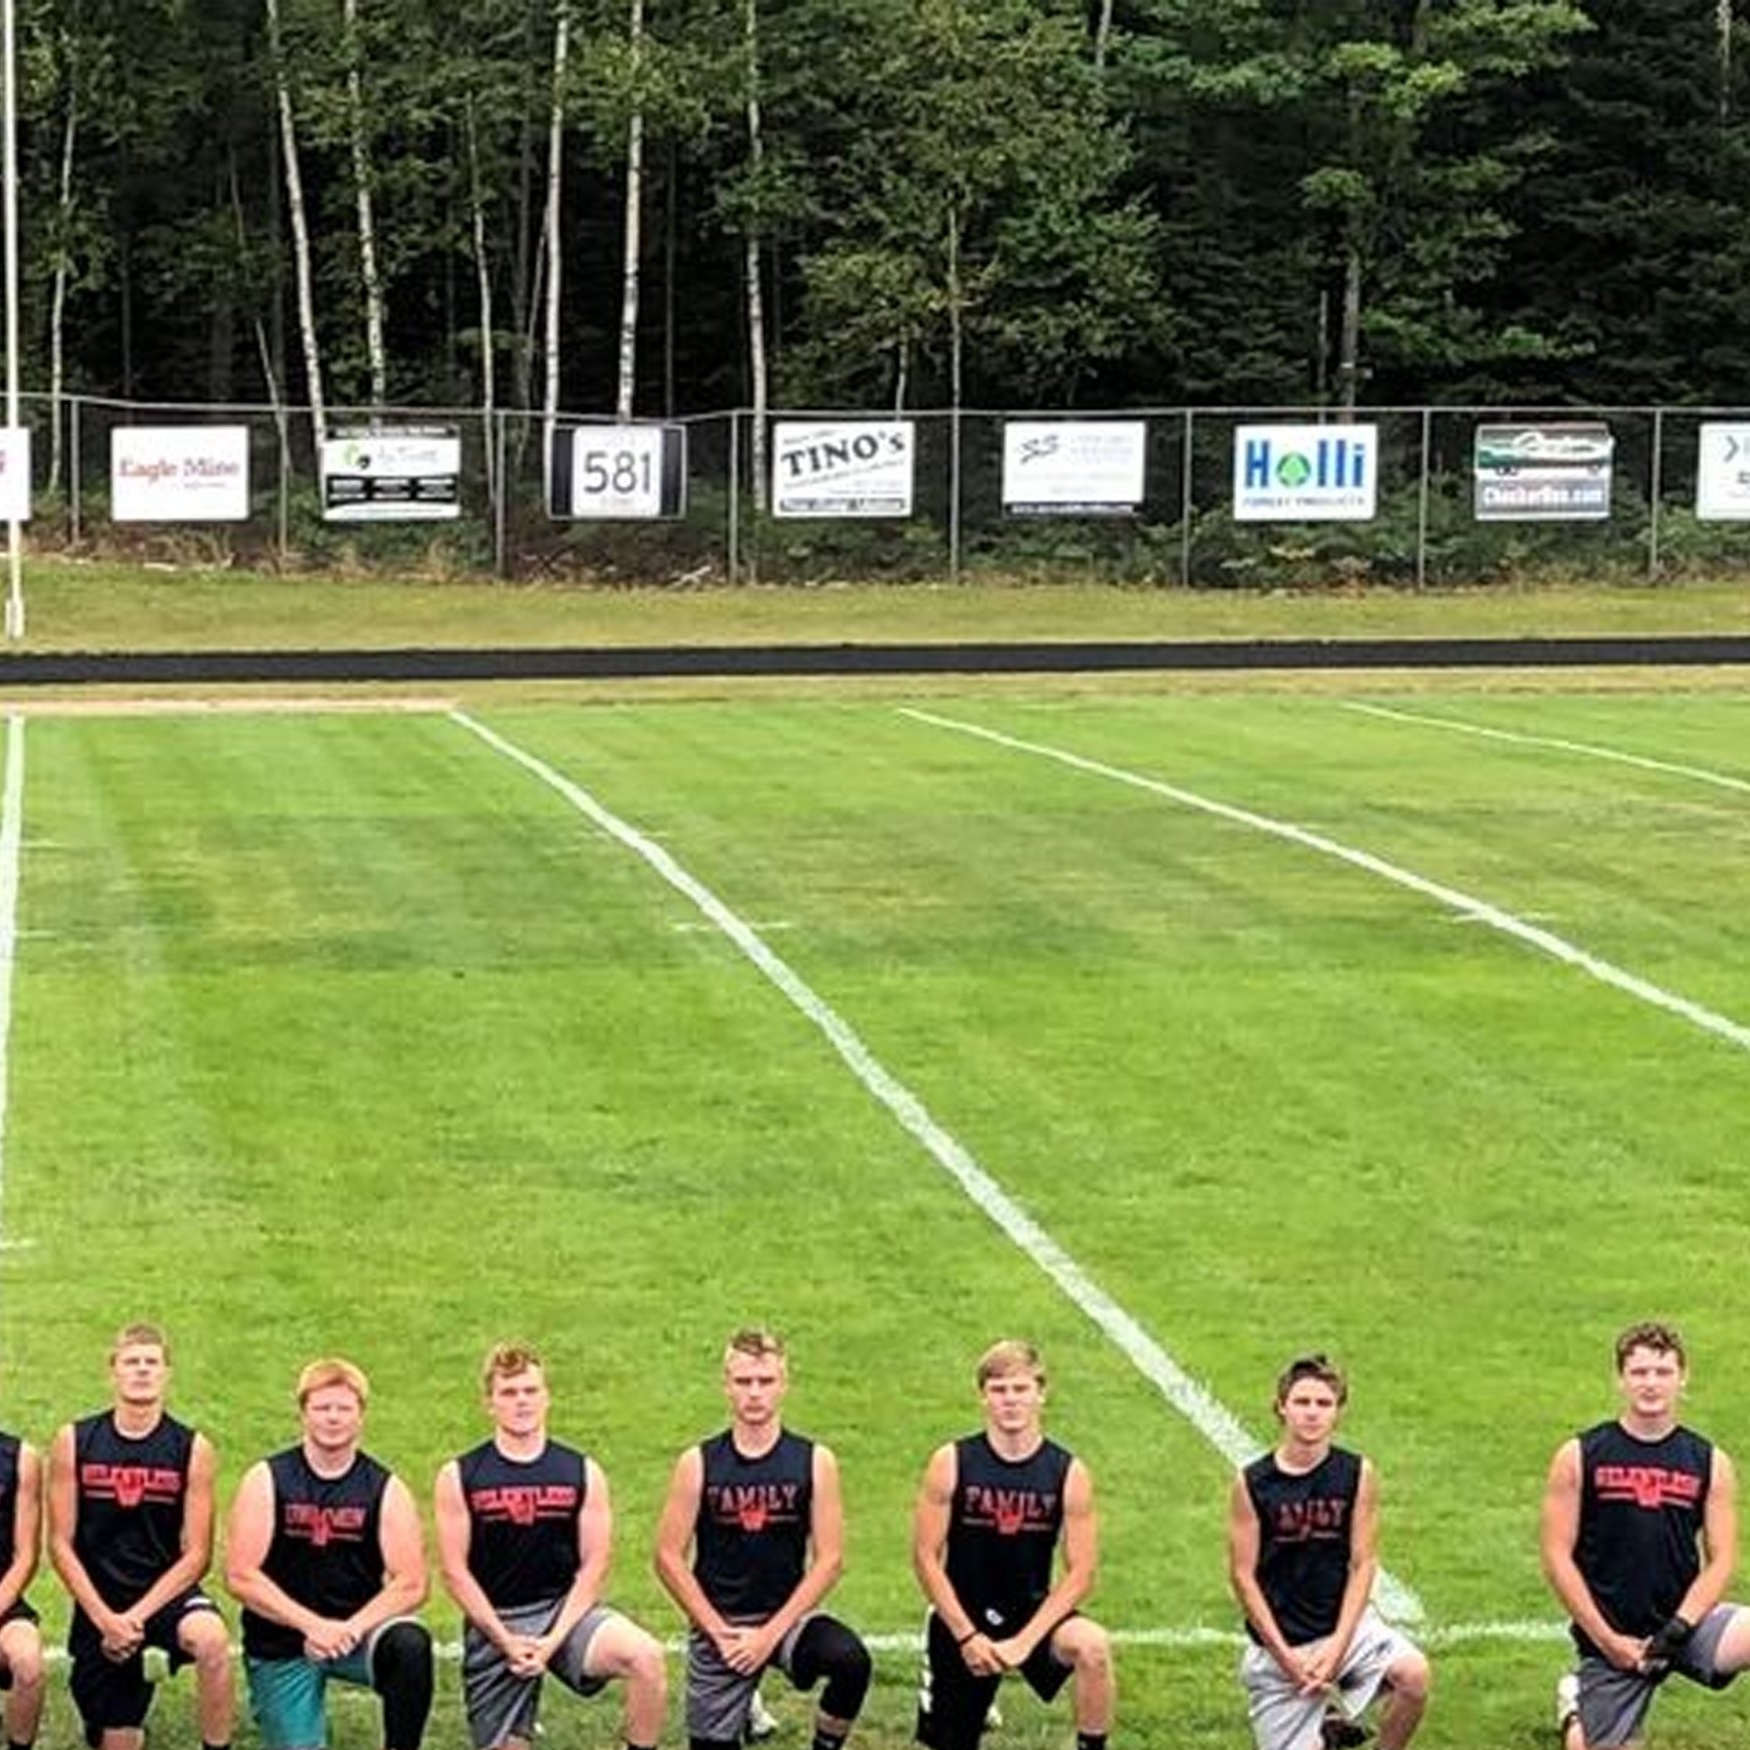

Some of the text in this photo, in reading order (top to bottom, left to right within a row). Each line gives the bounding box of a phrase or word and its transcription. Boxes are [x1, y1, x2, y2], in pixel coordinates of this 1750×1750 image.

[118, 457, 239, 485] Eagle Mine
[779, 430, 906, 477] TINO's
[1245, 438, 1366, 489] Holli
[583, 450, 652, 495] 581
[707, 1483, 801, 1512] FAMILY
[964, 1485, 1057, 1515] FAMILY
